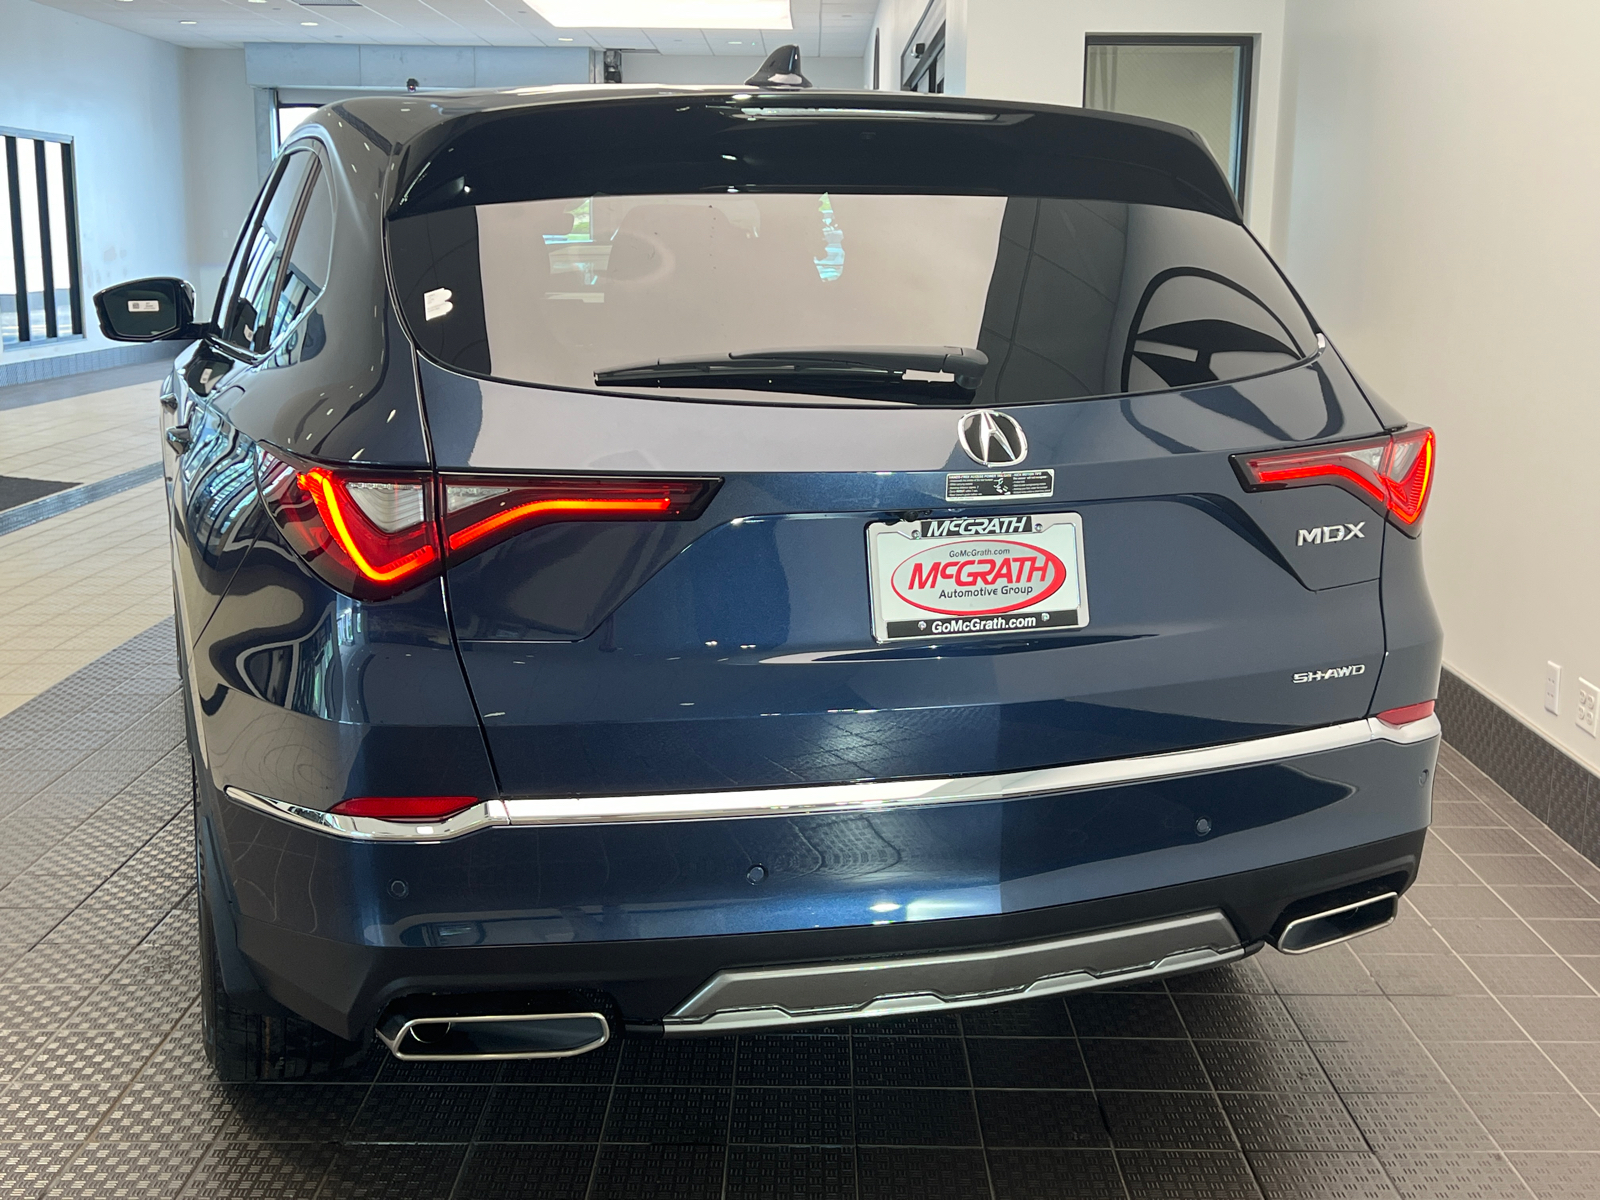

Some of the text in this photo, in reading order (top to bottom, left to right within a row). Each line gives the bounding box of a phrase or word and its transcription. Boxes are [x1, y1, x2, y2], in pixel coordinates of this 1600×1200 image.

[1297, 522, 1366, 546] MDX
[949, 548, 1010, 558] GoMcGrath.com
[939, 585, 1033, 599] Automotive Group
[932, 616, 1036, 634] GoMcGrath.com
[1293, 664, 1366, 684] SH-AWD
